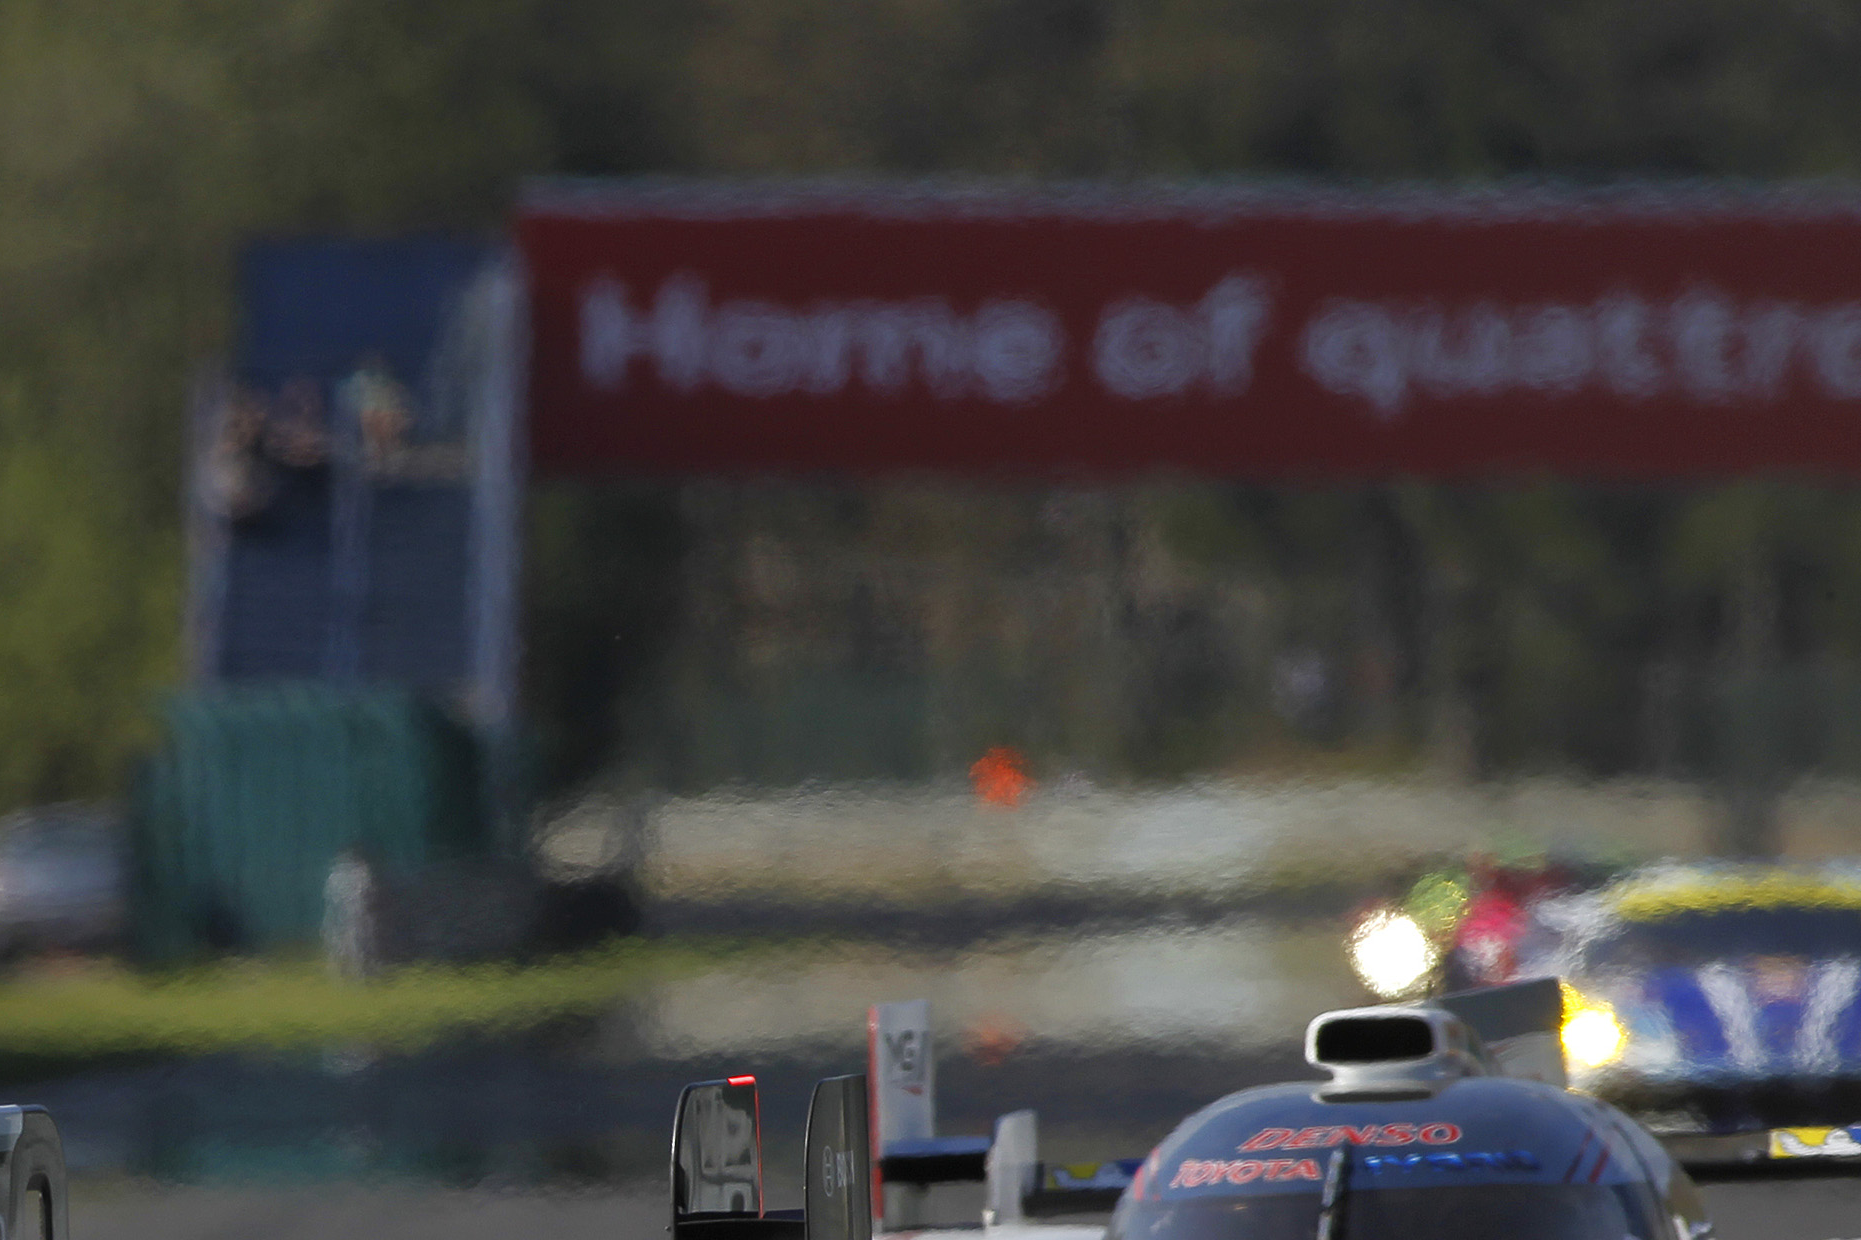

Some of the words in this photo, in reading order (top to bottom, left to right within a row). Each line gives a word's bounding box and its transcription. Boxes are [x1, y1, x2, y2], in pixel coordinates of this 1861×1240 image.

[578, 270, 1060, 402] Home
[1090, 268, 1274, 400] of
[1238, 1121, 1463, 1153] DENSO
[1170, 1157, 1323, 1190] TOYOTA
